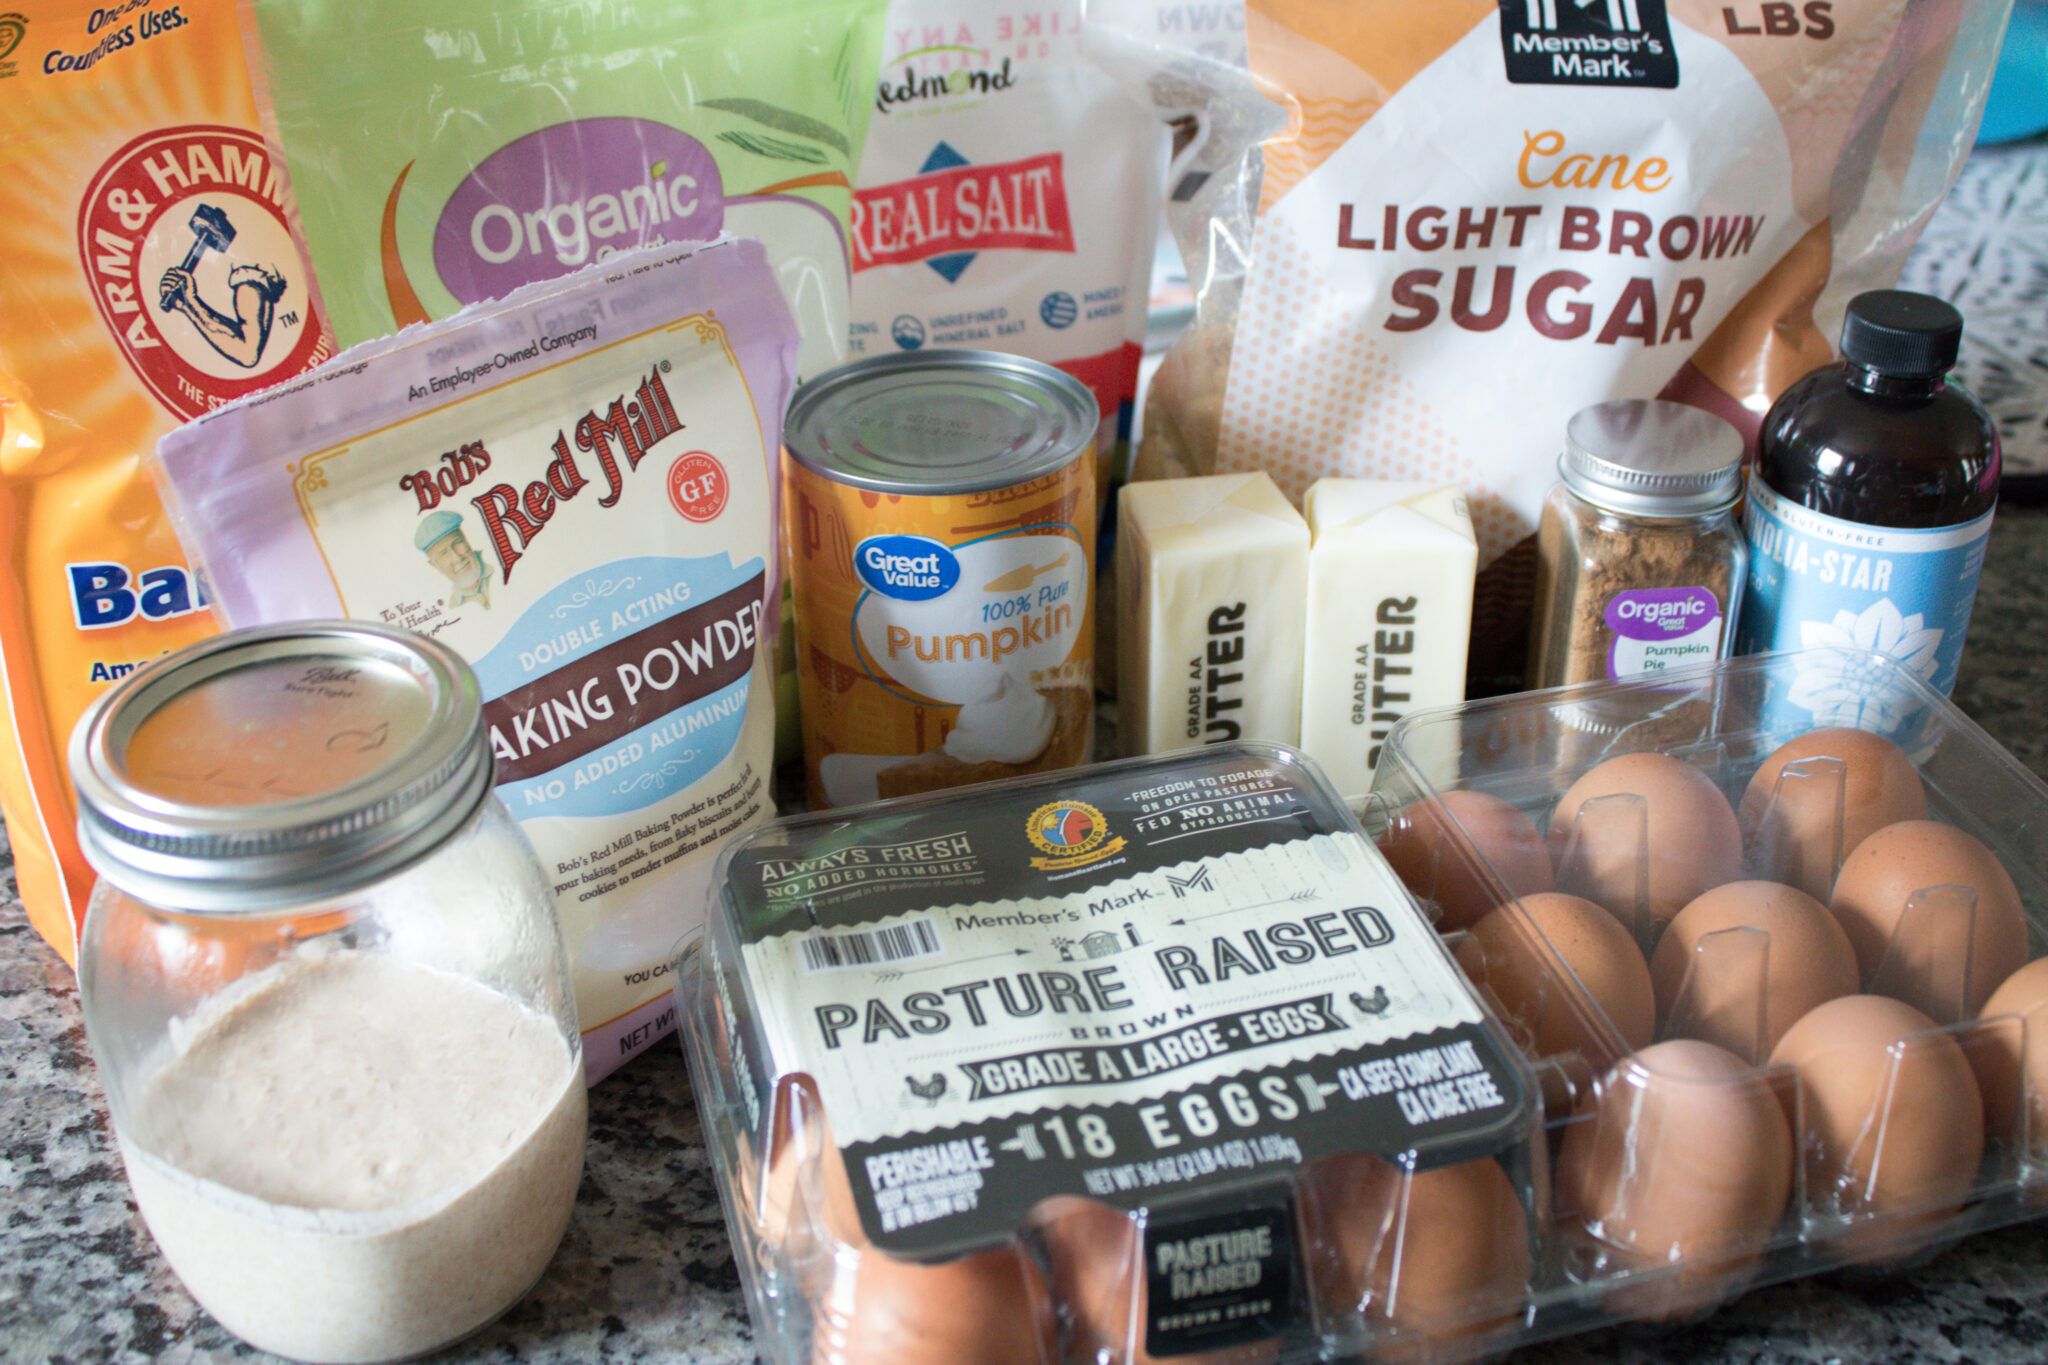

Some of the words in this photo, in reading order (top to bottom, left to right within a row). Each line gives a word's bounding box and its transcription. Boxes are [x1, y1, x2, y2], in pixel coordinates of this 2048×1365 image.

[43, 25, 135, 74] Countless
[139, 5, 189, 39] Uses.
[88, 4, 125, 34] One
[1722, 1, 1835, 40] LBS
[1513, 32, 1664, 54] Member's
[876, 57, 1018, 114] edmond
[1553, 54, 1631, 78] Mark
[142, 144, 284, 207] HAMM
[1517, 130, 1672, 193] Cane
[107, 187, 158, 230] &
[470, 159, 699, 266] Organic
[851, 188, 949, 263] REAL
[955, 166, 1056, 238] SALT
[1337, 204, 1542, 252] LIGHT
[1558, 205, 1766, 262] BROWN
[95, 227, 162, 351] ARM
[1383, 266, 1707, 347] SUGAR
[279, 311, 299, 328] TM
[850, 323, 879, 335] ZING
[308, 334, 331, 368] PUR
[408, 385, 428, 402] An
[429, 343, 540, 394] Employee-Owned
[540, 324, 598, 354] Company
[177, 374, 204, 406] THE
[470, 429, 590, 585] Red
[575, 364, 687, 508] Mill
[674, 459, 712, 484] GLUTEN
[680, 471, 717, 502] GF
[690, 495, 720, 515] FREE
[1784, 511, 1885, 546] GLUTEN-FREE
[865, 547, 940, 574] Great
[1752, 512, 1894, 592] NOLIA-STAR
[66, 561, 218, 631] Ba
[883, 569, 941, 588] Value
[380, 608, 396, 622] To
[395, 602, 421, 616] Your
[405, 605, 442, 629] Health
[982, 596, 1031, 623] 100%
[1038, 580, 1070, 604] Pure
[1617, 596, 1705, 622] Organic
[1657, 616, 1686, 626] Great
[518, 619, 603, 672] DOUBLE
[610, 582, 692, 631] ACTING
[886, 604, 1072, 663] Pumpkin
[1189, 657, 1202, 682] AA
[1355, 644, 1368, 666] AA
[1644, 660, 1666, 669] Pie
[1645, 643, 1710, 656] Pumpkin
[1205, 601, 1247, 745] UTTER
[489, 677, 615, 761] AKING
[1187, 685, 1202, 738] GRADE
[1352, 673, 1367, 725] GRADE
[523, 780, 565, 806] NO
[573, 743, 643, 791] ADDED
[1131, 780, 1196, 802] FREEDOM
[1198, 777, 1217, 787] TO
[1220, 768, 1273, 785] FORAGE
[1136, 815, 1172, 833] FED
[1179, 805, 1214, 820] NO
[1223, 793, 1296, 812] ANIMAL
[1142, 803, 1160, 813] ON
[1165, 791, 1200, 807] OPEN
[1205, 779, 1275, 798] PASTURES
[557, 855, 589, 875] Bob's
[589, 846, 611, 864] Red
[612, 834, 634, 853] Mill
[634, 819, 670, 842] Baking
[670, 801, 706, 825] Powder
[706, 796, 716, 808] is
[1180, 808, 1270, 831] BYPRODUCTS
[554, 878, 579, 896] your
[581, 861, 619, 884] baking
[618, 848, 648, 868] needs,
[649, 836, 673, 853] from
[674, 822, 697, 841] flaky
[697, 806, 733, 829] biscuits
[762, 849, 870, 882] ALWAYS
[881, 836, 972, 862] FRESH
[1042, 831, 1103, 853] CERTIFIED
[578, 881, 617, 902] cookies
[619, 873, 630, 885] to
[631, 858, 662, 881] tender
[663, 841, 699, 863] muffins
[700, 829, 719, 847] and
[766, 884, 800, 898] NO
[807, 869, 866, 891] ADDED
[955, 908, 1080, 931] Member's
[1088, 887, 1154, 916] Mark
[624, 970, 650, 986] YOU
[813, 965, 1135, 1050] PASTURE
[1155, 906, 1396, 990] RAISED
[619, 1022, 652, 1055] NET
[1070, 1004, 1194, 1041] BROWN
[981, 1056, 1092, 1096] GRADE
[1098, 1053, 1122, 1081] A
[1124, 1028, 1228, 1075] LARGE
[1246, 1004, 1325, 1042] EGGS
[1043, 1114, 1116, 1159] 18
[1139, 1076, 1298, 1149] EGGS
[865, 1136, 995, 1192] PERISHABLE
[1156, 1225, 1273, 1275] PASTURE
[1171, 1259, 1262, 1300] RAISED
